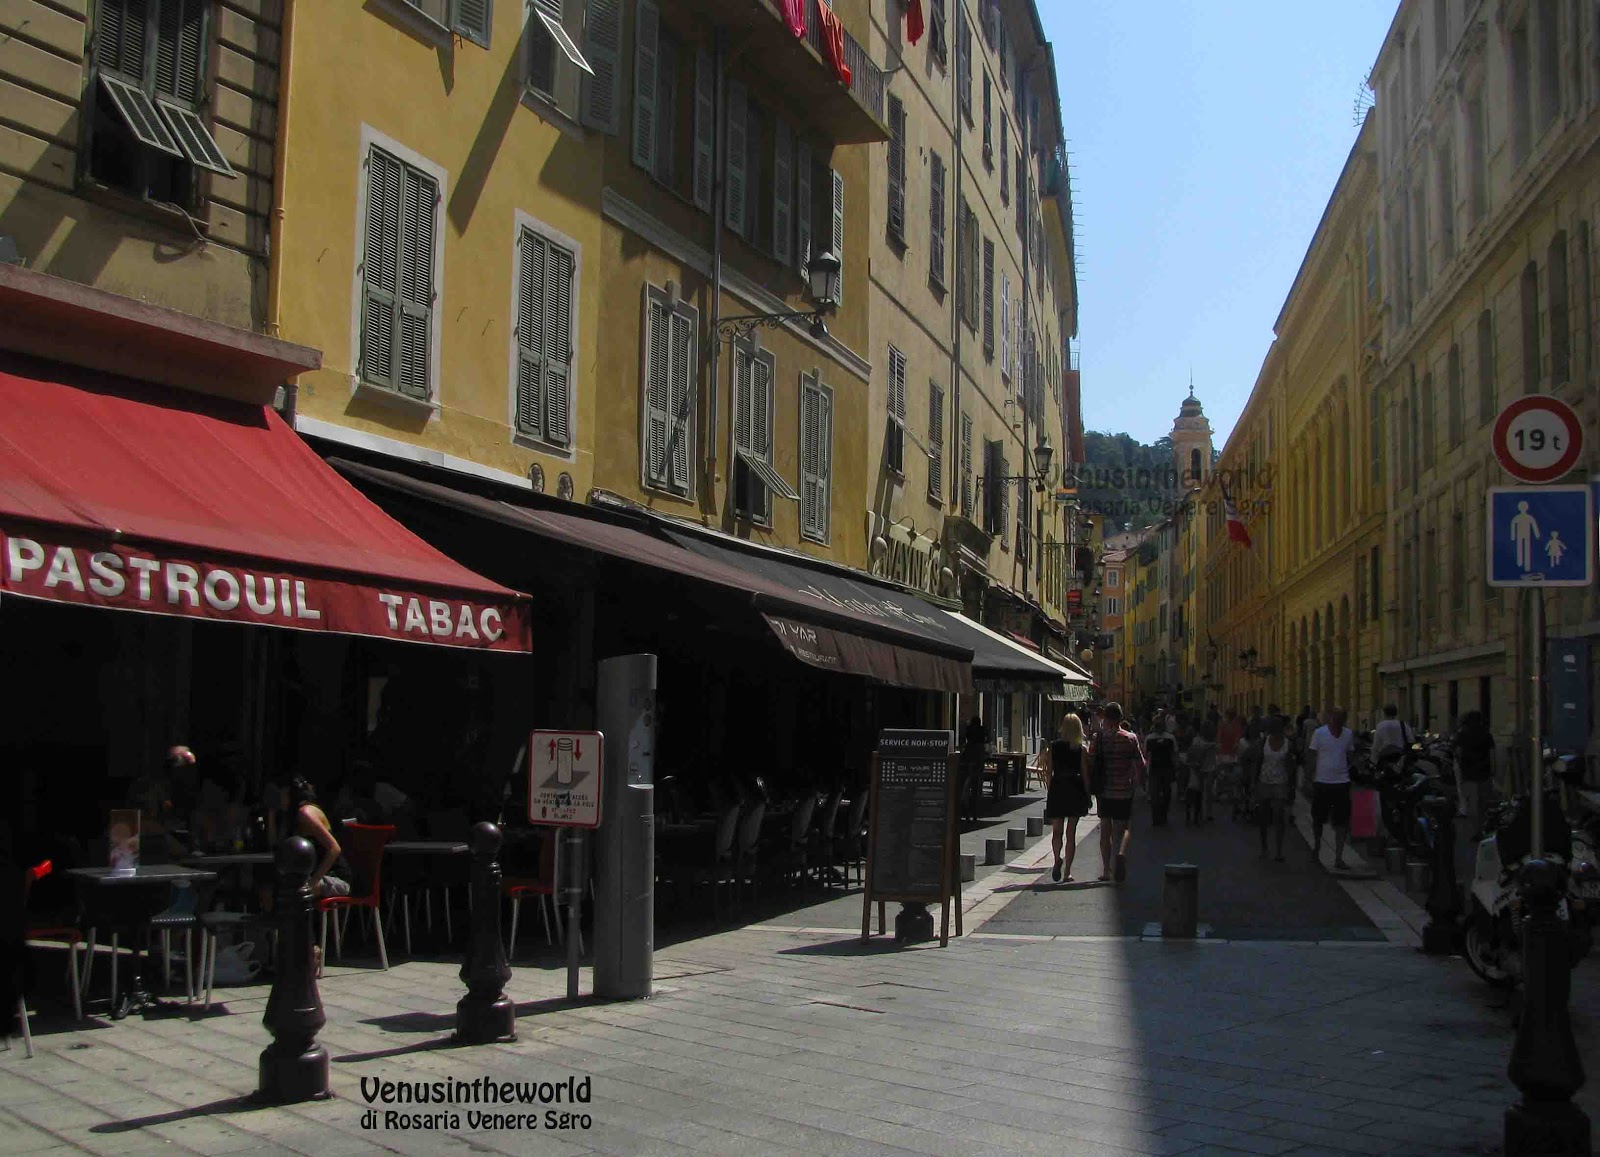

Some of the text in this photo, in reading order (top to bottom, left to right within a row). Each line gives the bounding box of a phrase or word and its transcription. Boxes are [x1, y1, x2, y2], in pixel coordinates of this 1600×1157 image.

[1514, 428, 1561, 451] 19 t
[8, 536, 503, 642] PASTROUIL TABAC
[789, 623, 818, 645] YAR
[880, 738, 948, 747] SERVICE NON-STOP
